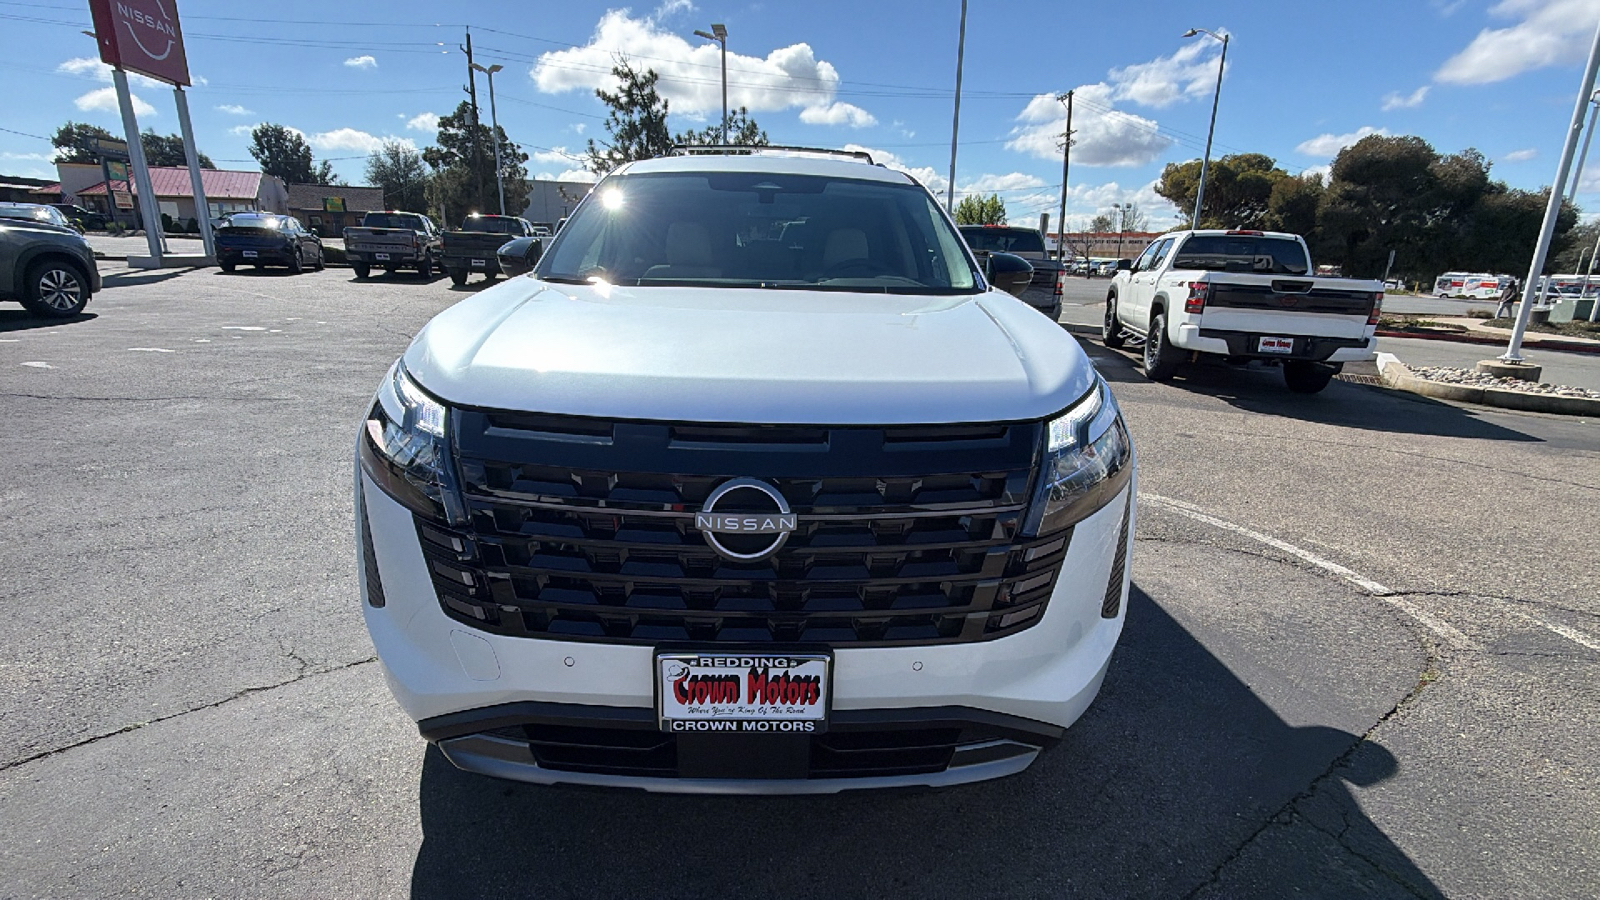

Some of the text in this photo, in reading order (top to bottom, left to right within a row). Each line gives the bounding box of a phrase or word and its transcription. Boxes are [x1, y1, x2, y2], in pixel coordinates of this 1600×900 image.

[116, 1, 176, 38] NISSAN
[697, 515, 794, 531] NISSAN
[700, 657, 788, 668] REDDING
[673, 667, 821, 706] Crown Motors
[687, 706, 710, 714] Where
[737, 706, 755, 715] King
[757, 706, 768, 715] Of
[769, 706, 783, 714] The
[785, 706, 806, 714] Road
[672, 720, 815, 732] CROWN MOTORS
